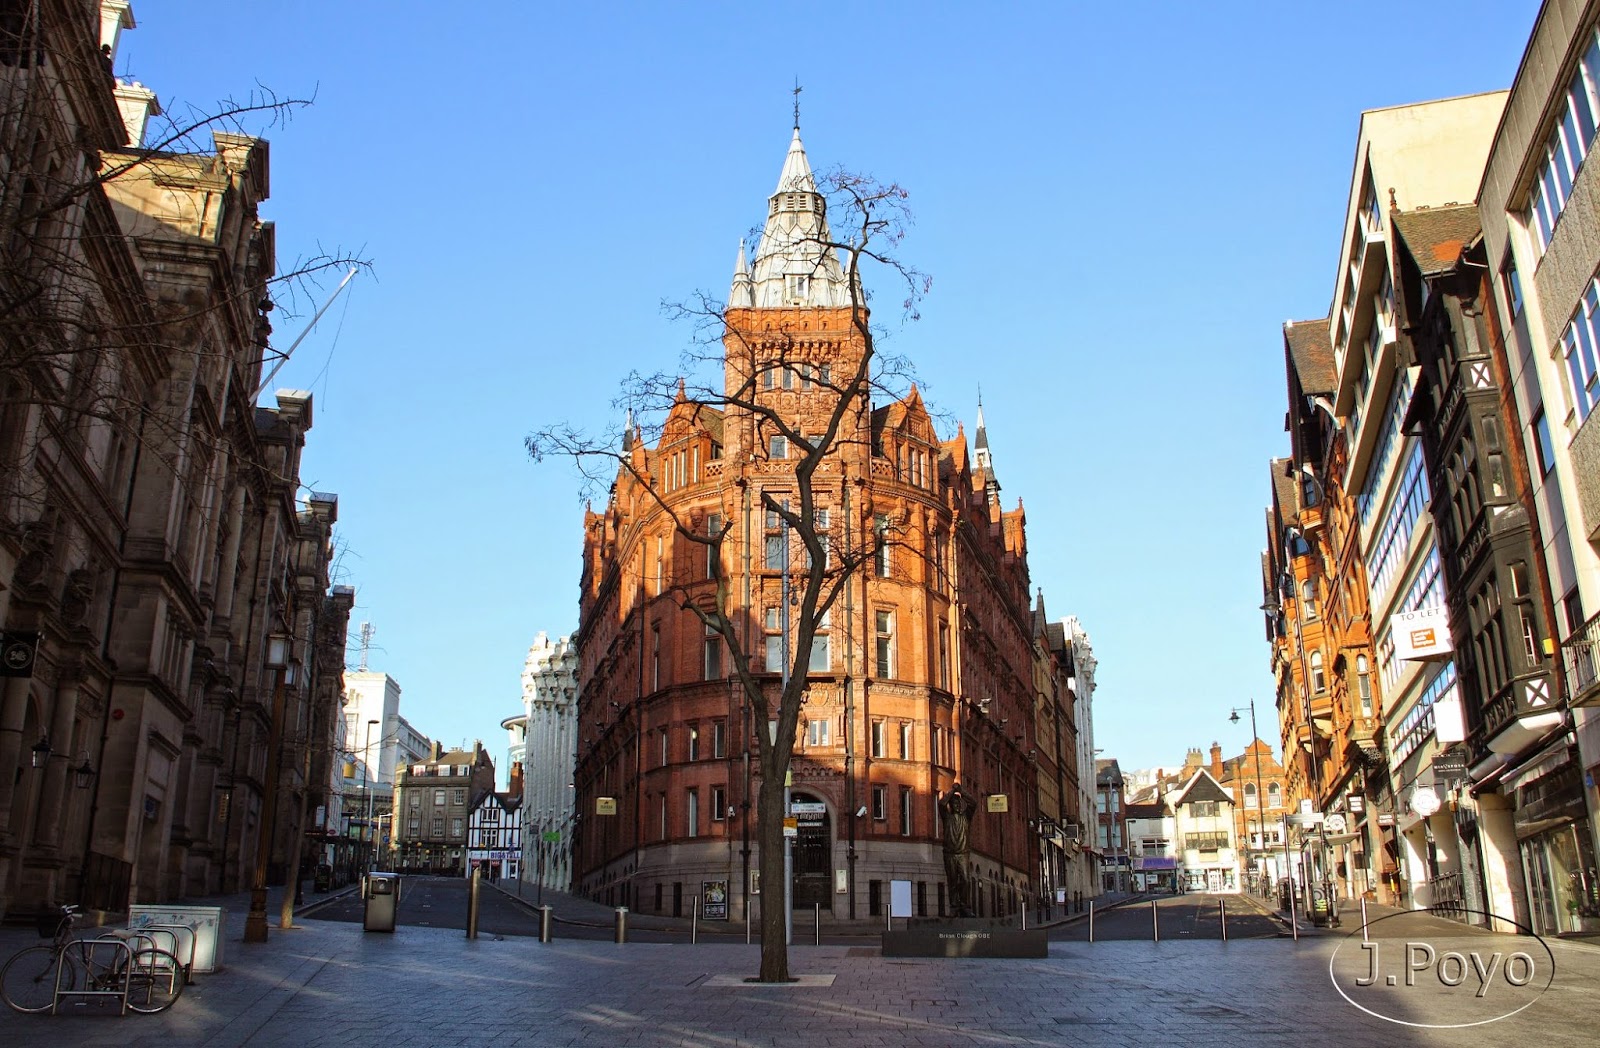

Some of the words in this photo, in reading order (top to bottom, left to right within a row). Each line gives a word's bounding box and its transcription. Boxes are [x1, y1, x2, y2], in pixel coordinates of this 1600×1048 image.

[1401, 613, 1415, 621] TO
[1420, 608, 1440, 618] LET
[956, 932, 978, 940] Clough
